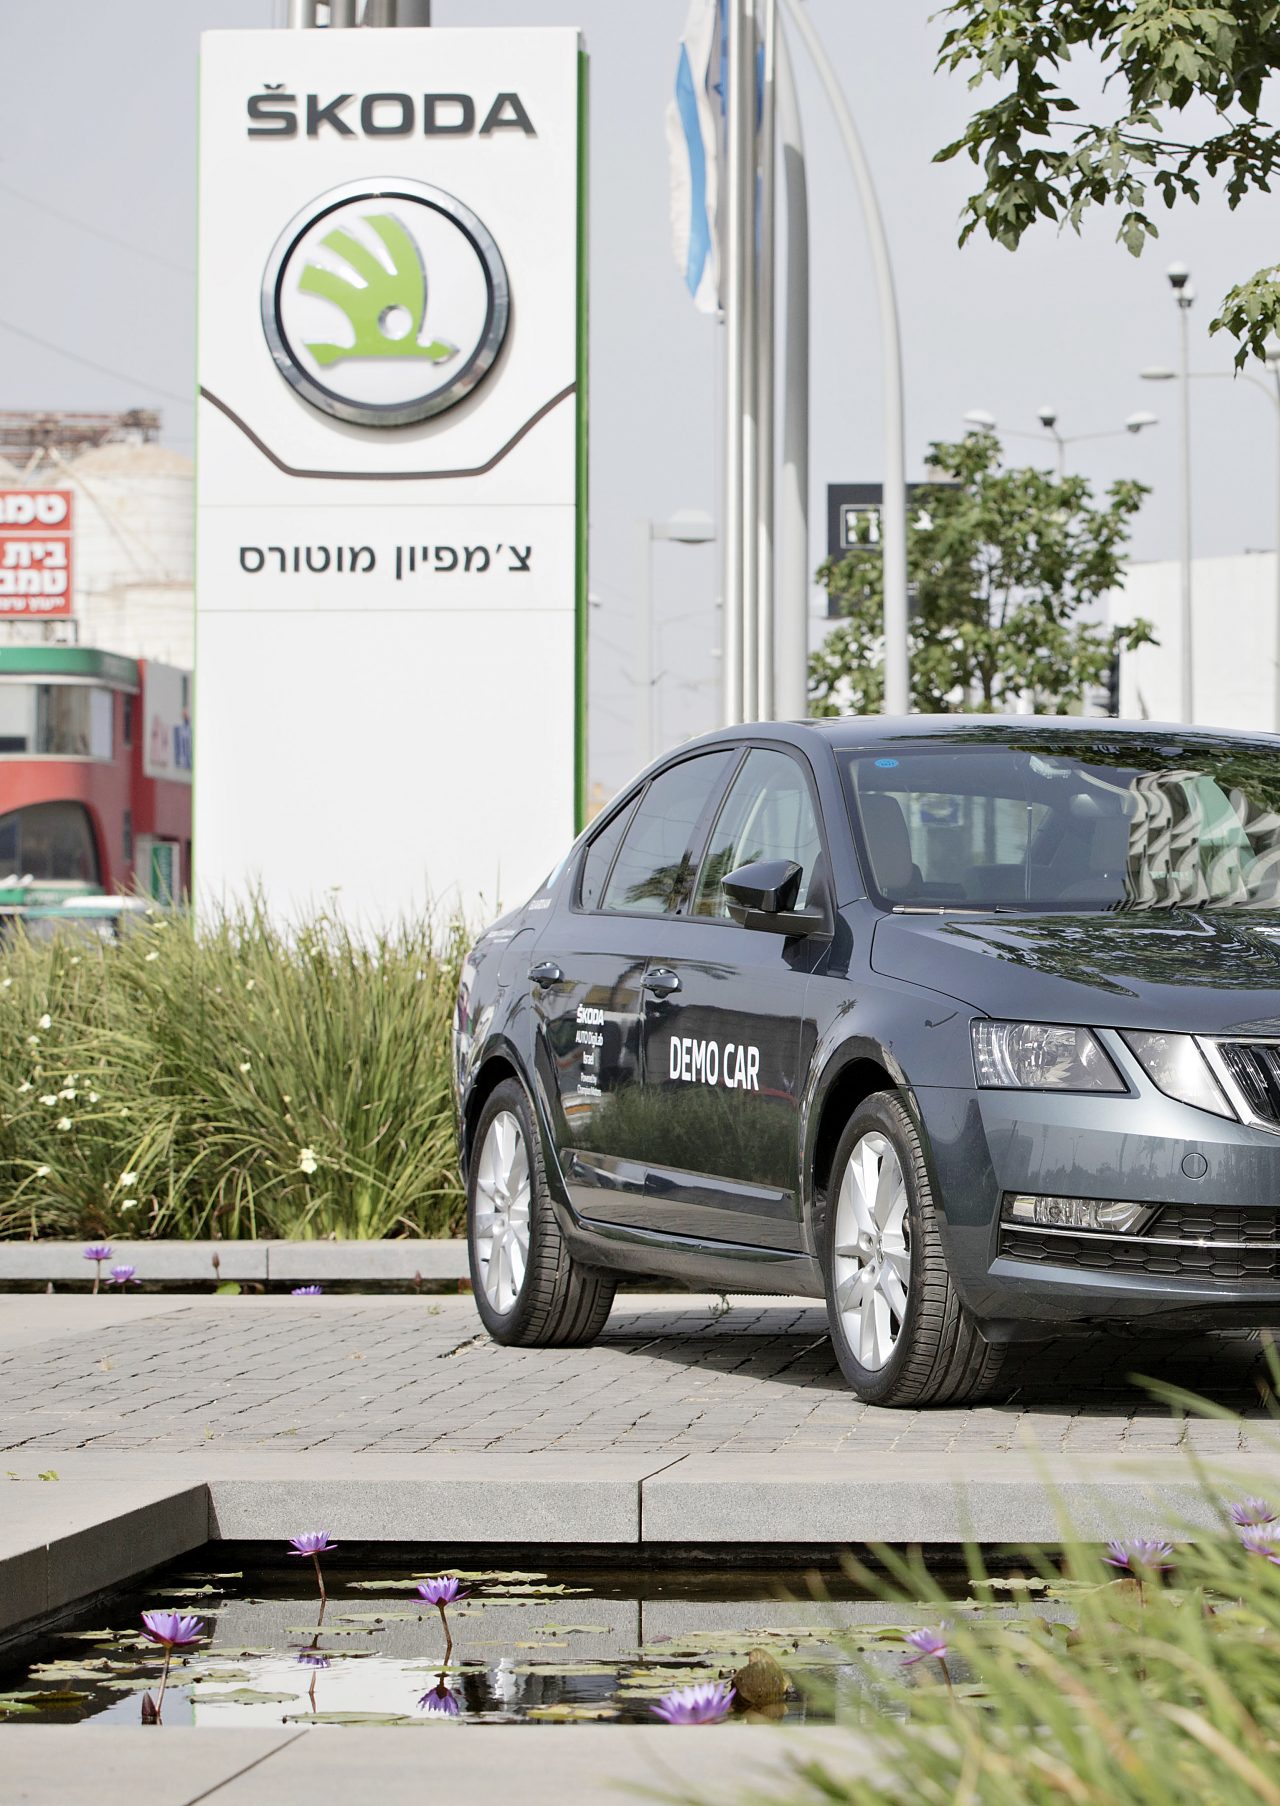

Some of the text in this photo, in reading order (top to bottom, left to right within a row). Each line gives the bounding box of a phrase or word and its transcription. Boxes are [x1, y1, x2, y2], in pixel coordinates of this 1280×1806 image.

[247, 83, 537, 137] ŠKODA
[3, 541, 67, 569] בית
[239, 545, 376, 573] מוטורס
[576, 1003, 605, 1026] ŠKODA
[669, 1035, 760, 1091] DEMO CAR
